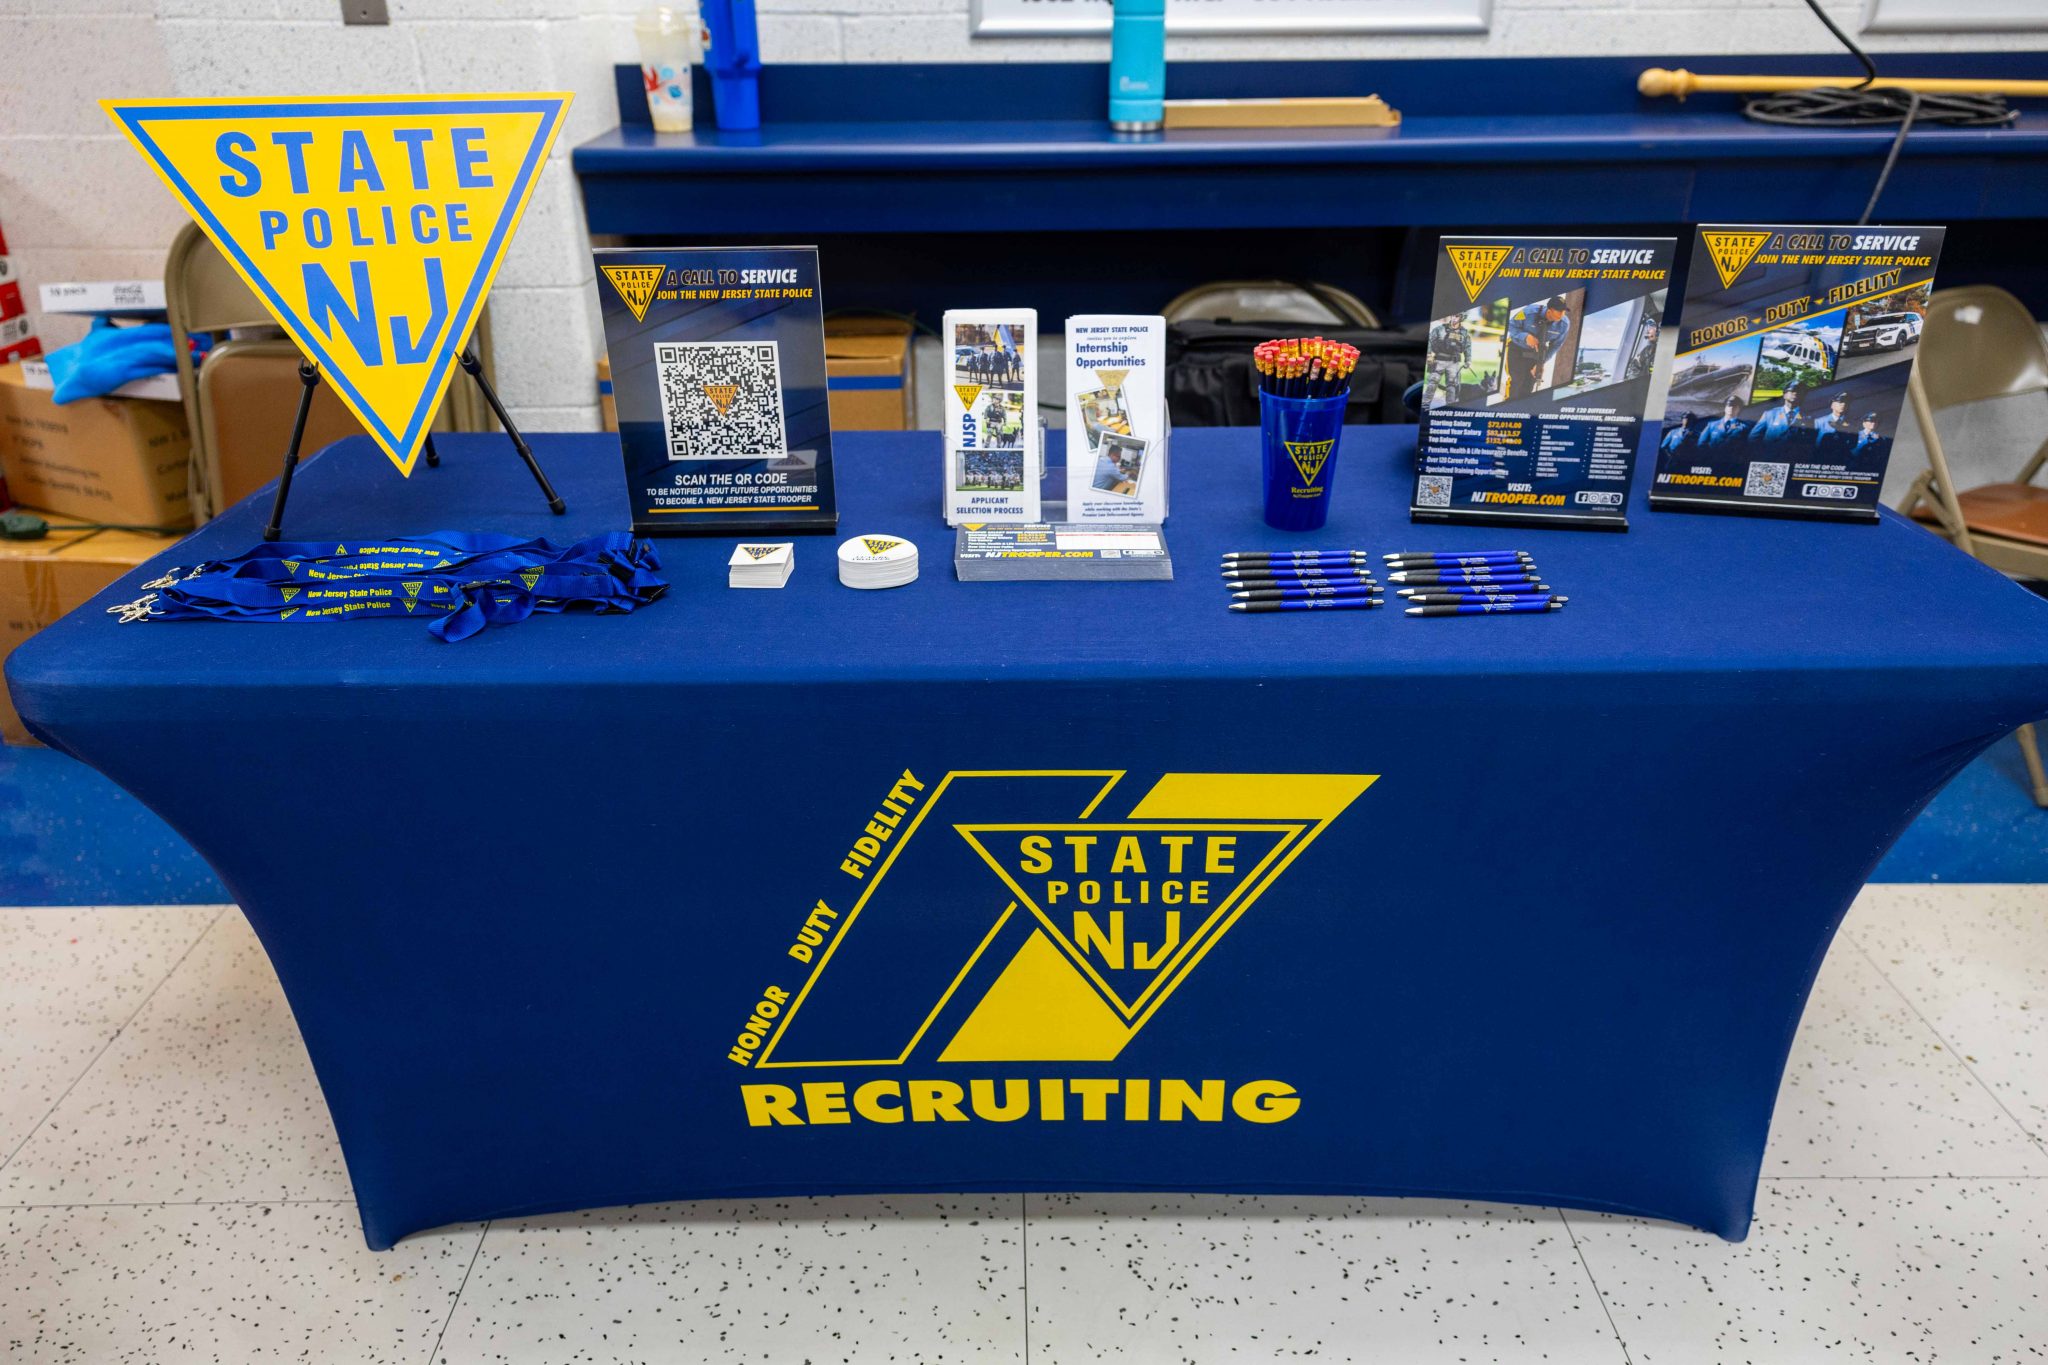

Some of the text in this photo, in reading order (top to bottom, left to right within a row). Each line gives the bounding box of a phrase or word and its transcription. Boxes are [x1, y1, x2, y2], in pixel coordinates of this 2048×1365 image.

[215, 128, 494, 197] STATE
[260, 204, 472, 250] POLICE
[1715, 237, 1755, 247] STATE
[1770, 234, 1920, 251] A CALL TO SERVICE
[1460, 252, 1498, 260] STATE
[1513, 248, 1654, 264] A CALL TO SERVICE
[1755, 255, 1931, 266] JOIN THE NEW JERSEY STATE POLICE
[1722, 257, 1742, 272] NJ
[616, 271, 653, 280] STATE
[667, 269, 797, 285] A CALL TO SERVICE
[1466, 270, 1485, 285] NJ
[1498, 268, 1666, 279] JOIN THE NEW JERSEY STATE POLICE
[627, 290, 646, 305] NJ
[657, 288, 813, 300] JOIN THE NEW JERSEY STATE POLICE
[301, 258, 448, 367] NJ
[1691, 268, 1901, 346] HONOR DUTY FIDELITY
[1076, 342, 1128, 354] Internship
[1076, 356, 1145, 368] Opportunities
[963, 414, 976, 447] NJSP
[1453, 420, 1472, 428] Salary
[1295, 445, 1327, 454] STATE
[1302, 461, 1319, 476] NJ
[675, 473, 787, 485] SCAN THE QR CODE
[1657, 473, 1743, 487] NJTROOPER.COM
[647, 488, 656, 496] TO
[1507, 483, 1533, 492] VISIT:
[777, 495, 812, 503] TROOPER
[1471, 492, 1566, 506] NJTROOPER.COM
[309, 569, 326, 578] New
[324, 590, 347, 598] Jersey
[350, 589, 368, 597] State
[370, 588, 392, 596] Police
[322, 607, 343, 615] Jersey
[344, 603, 365, 612] State
[1020, 836, 1237, 873] STATE
[1048, 881, 1210, 905] POLICE
[727, 768, 926, 1067] HONOR DUTY FIDELITY
[1073, 911, 1179, 970] NJ
[740, 1078, 1300, 1127] RECRUITING
